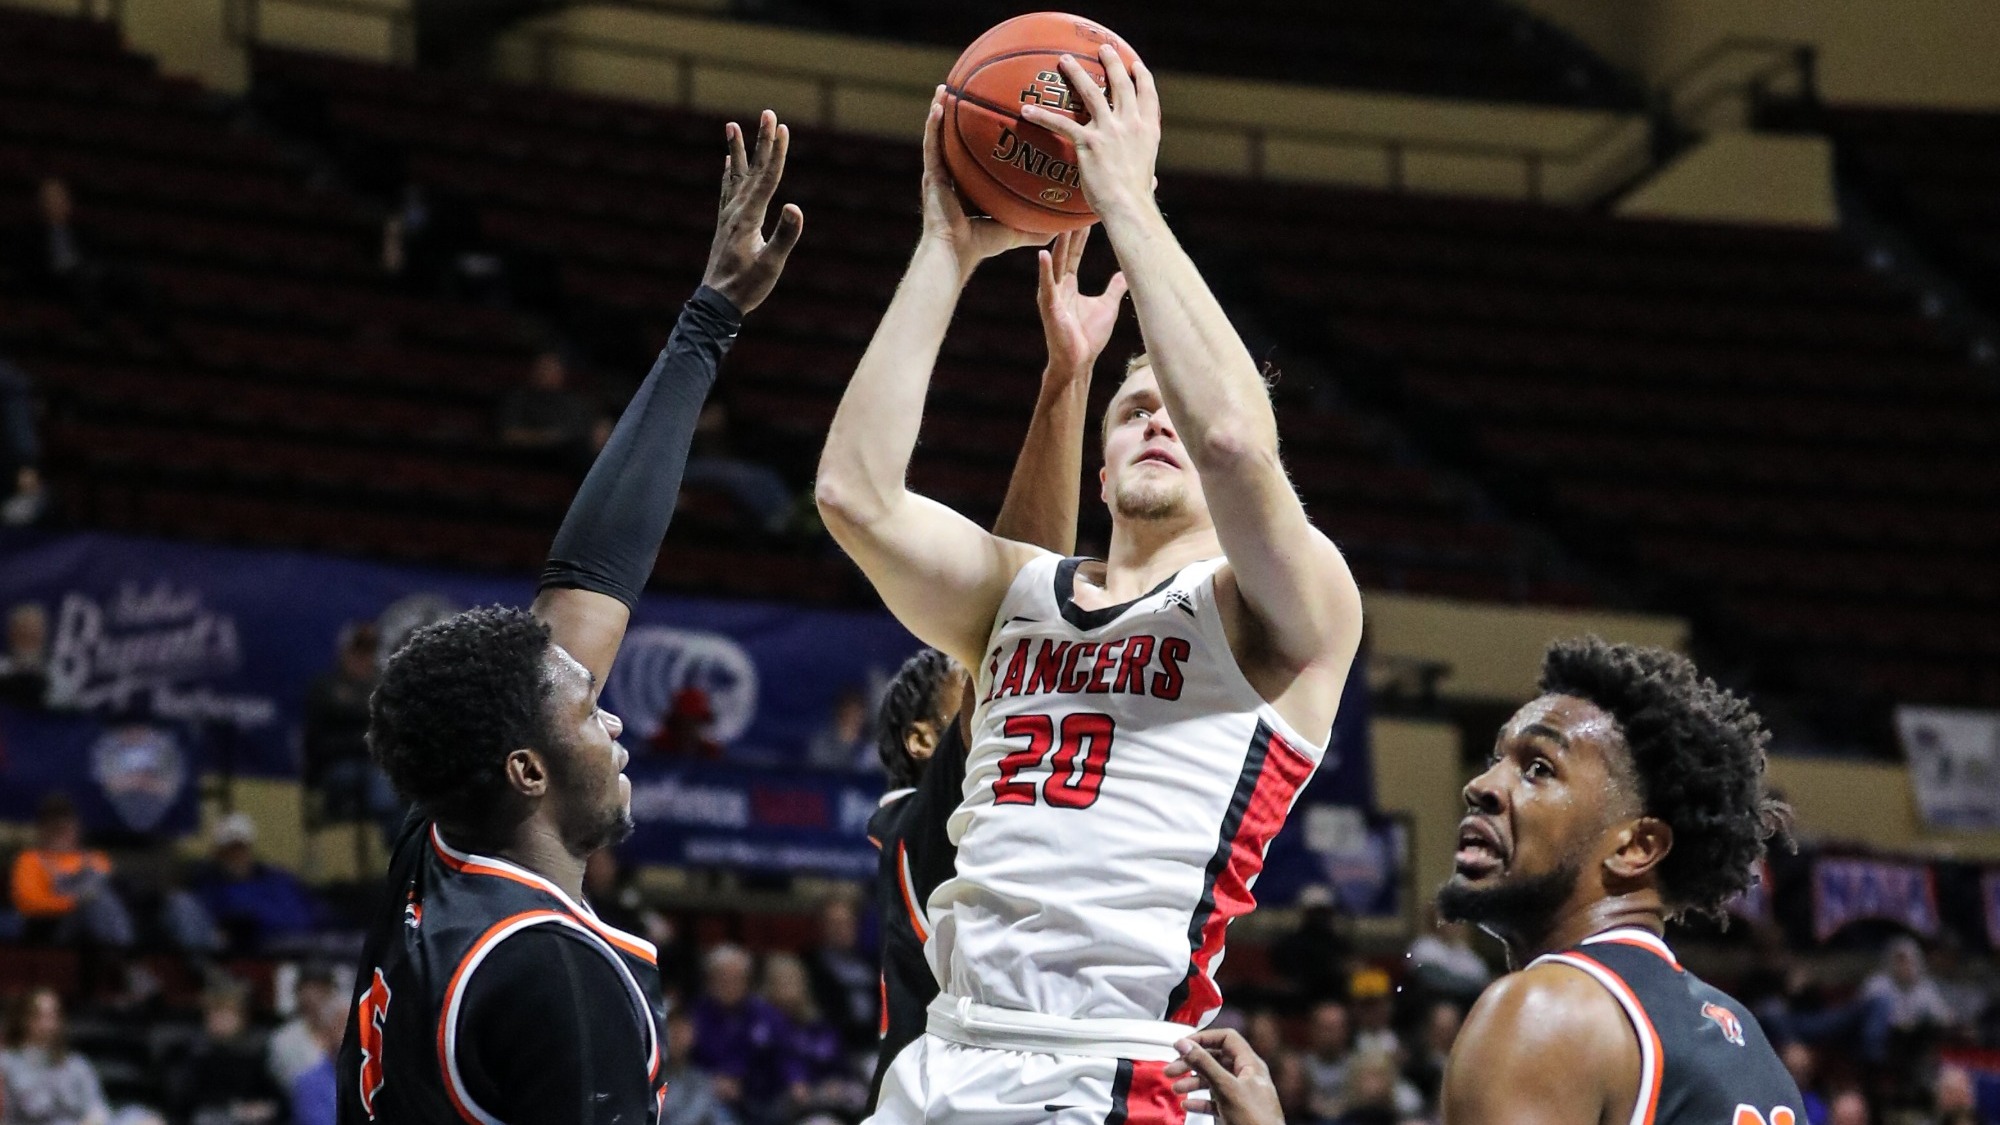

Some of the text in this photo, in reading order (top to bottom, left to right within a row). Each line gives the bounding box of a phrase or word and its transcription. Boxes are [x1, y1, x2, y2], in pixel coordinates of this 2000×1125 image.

[991, 127, 1080, 188] LDING
[981, 634, 1191, 702] LANCERS
[992, 712, 1116, 810] 20
